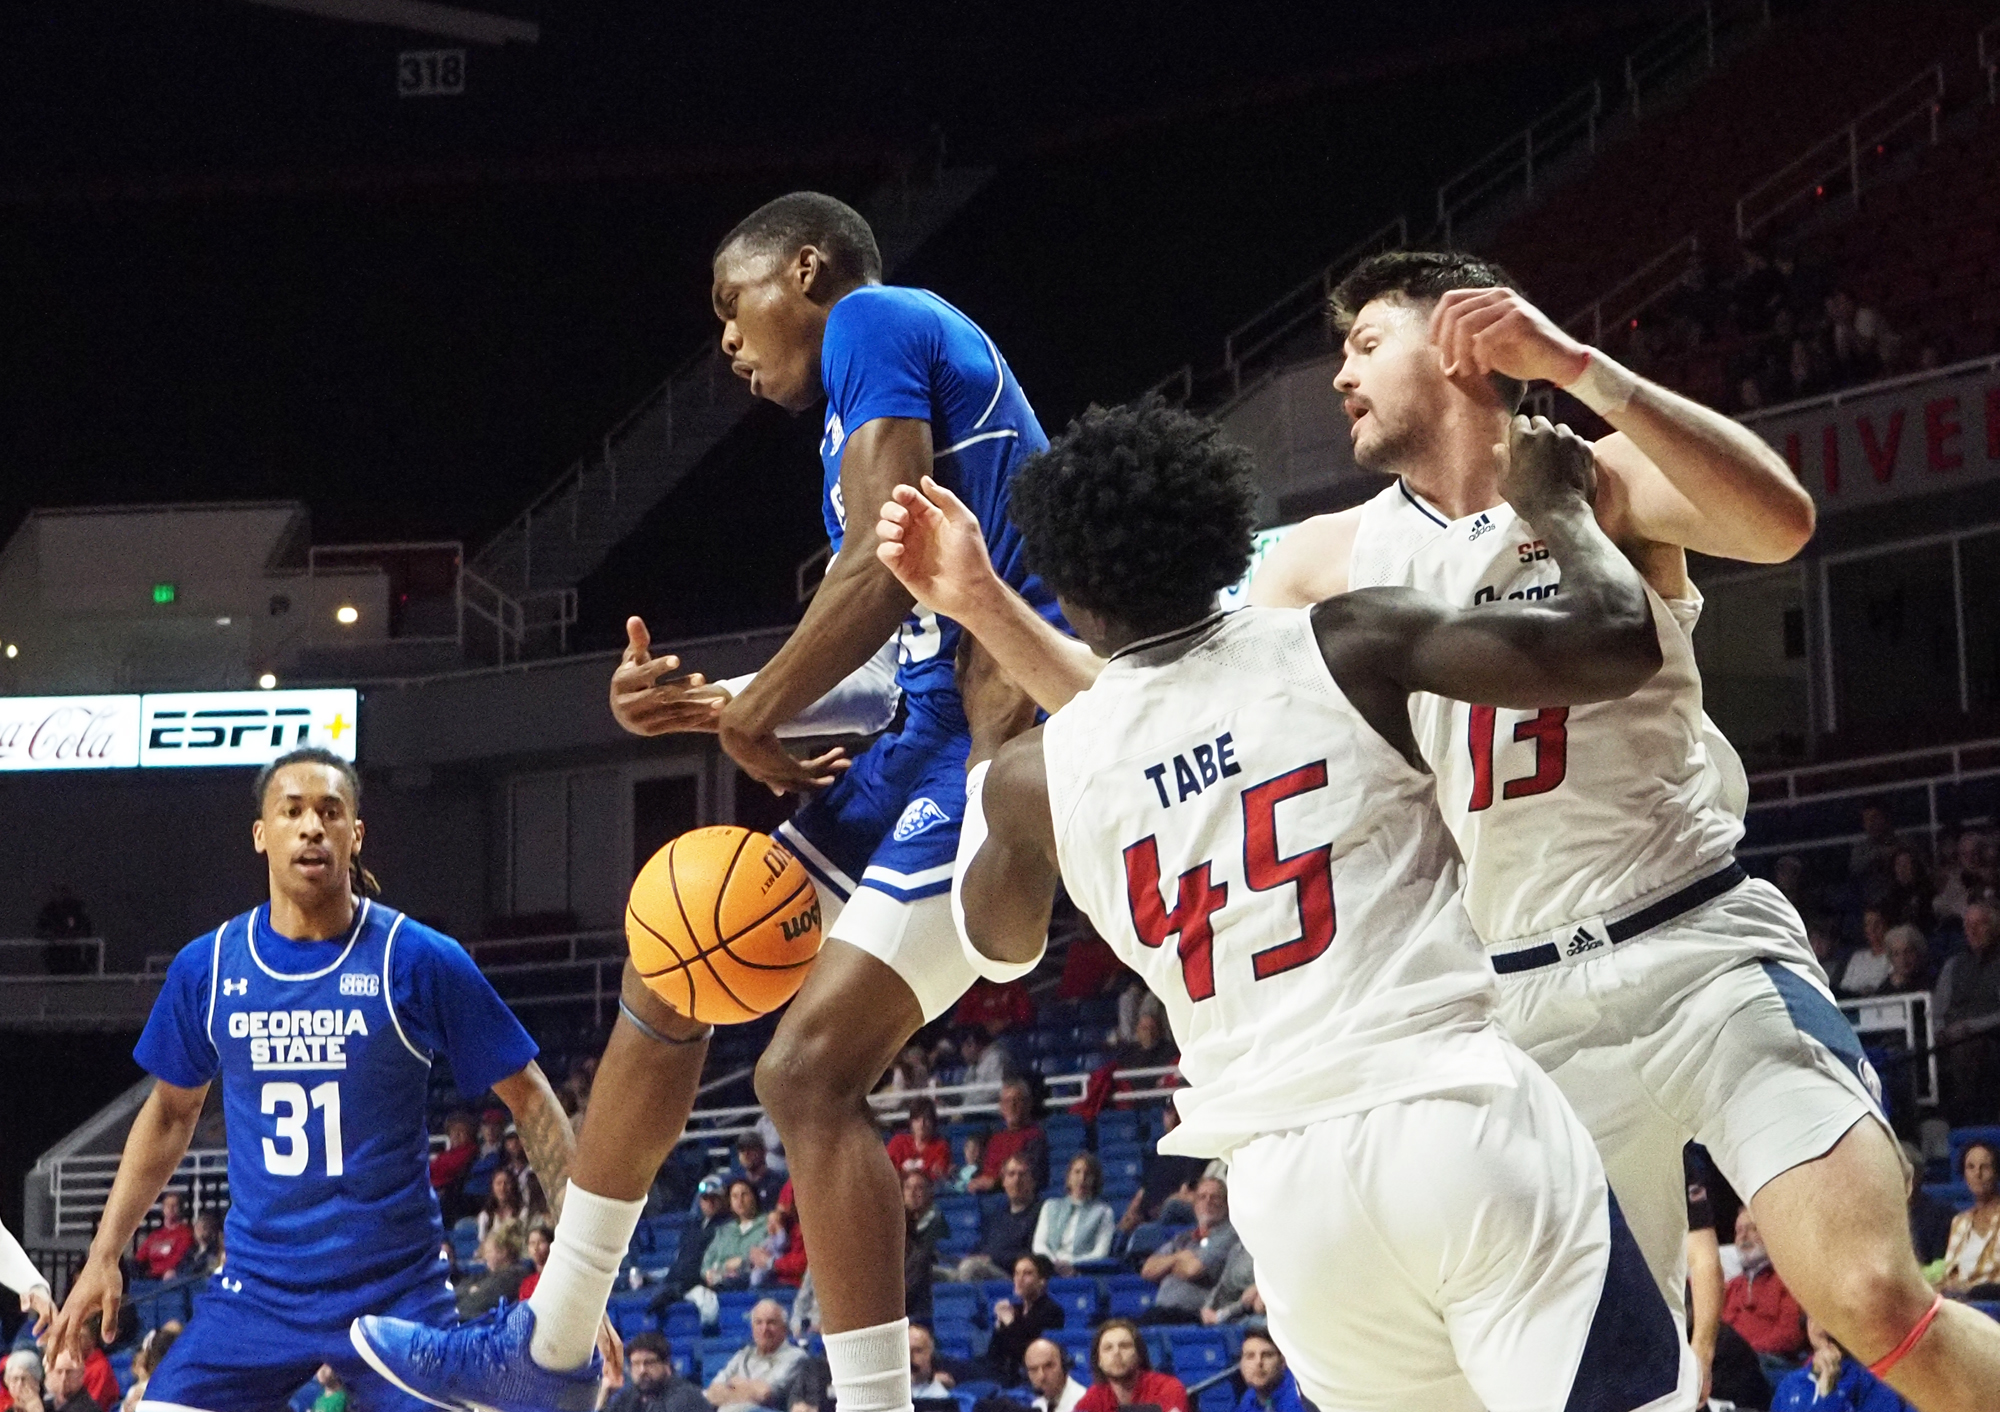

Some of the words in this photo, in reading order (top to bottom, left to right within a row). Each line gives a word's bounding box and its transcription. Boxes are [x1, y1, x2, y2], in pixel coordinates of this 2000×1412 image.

[402, 54, 462, 90] 318
[1468, 523, 1496, 542] adidas
[1144, 731, 1242, 809] TABE
[1468, 703, 1570, 813] 13
[1122, 758, 1337, 1003] 45
[1566, 939, 1604, 957] adidas
[228, 1009, 369, 1038] GEORGIA
[250, 1036, 347, 1063] STATE
[261, 1081, 343, 1177] 31
